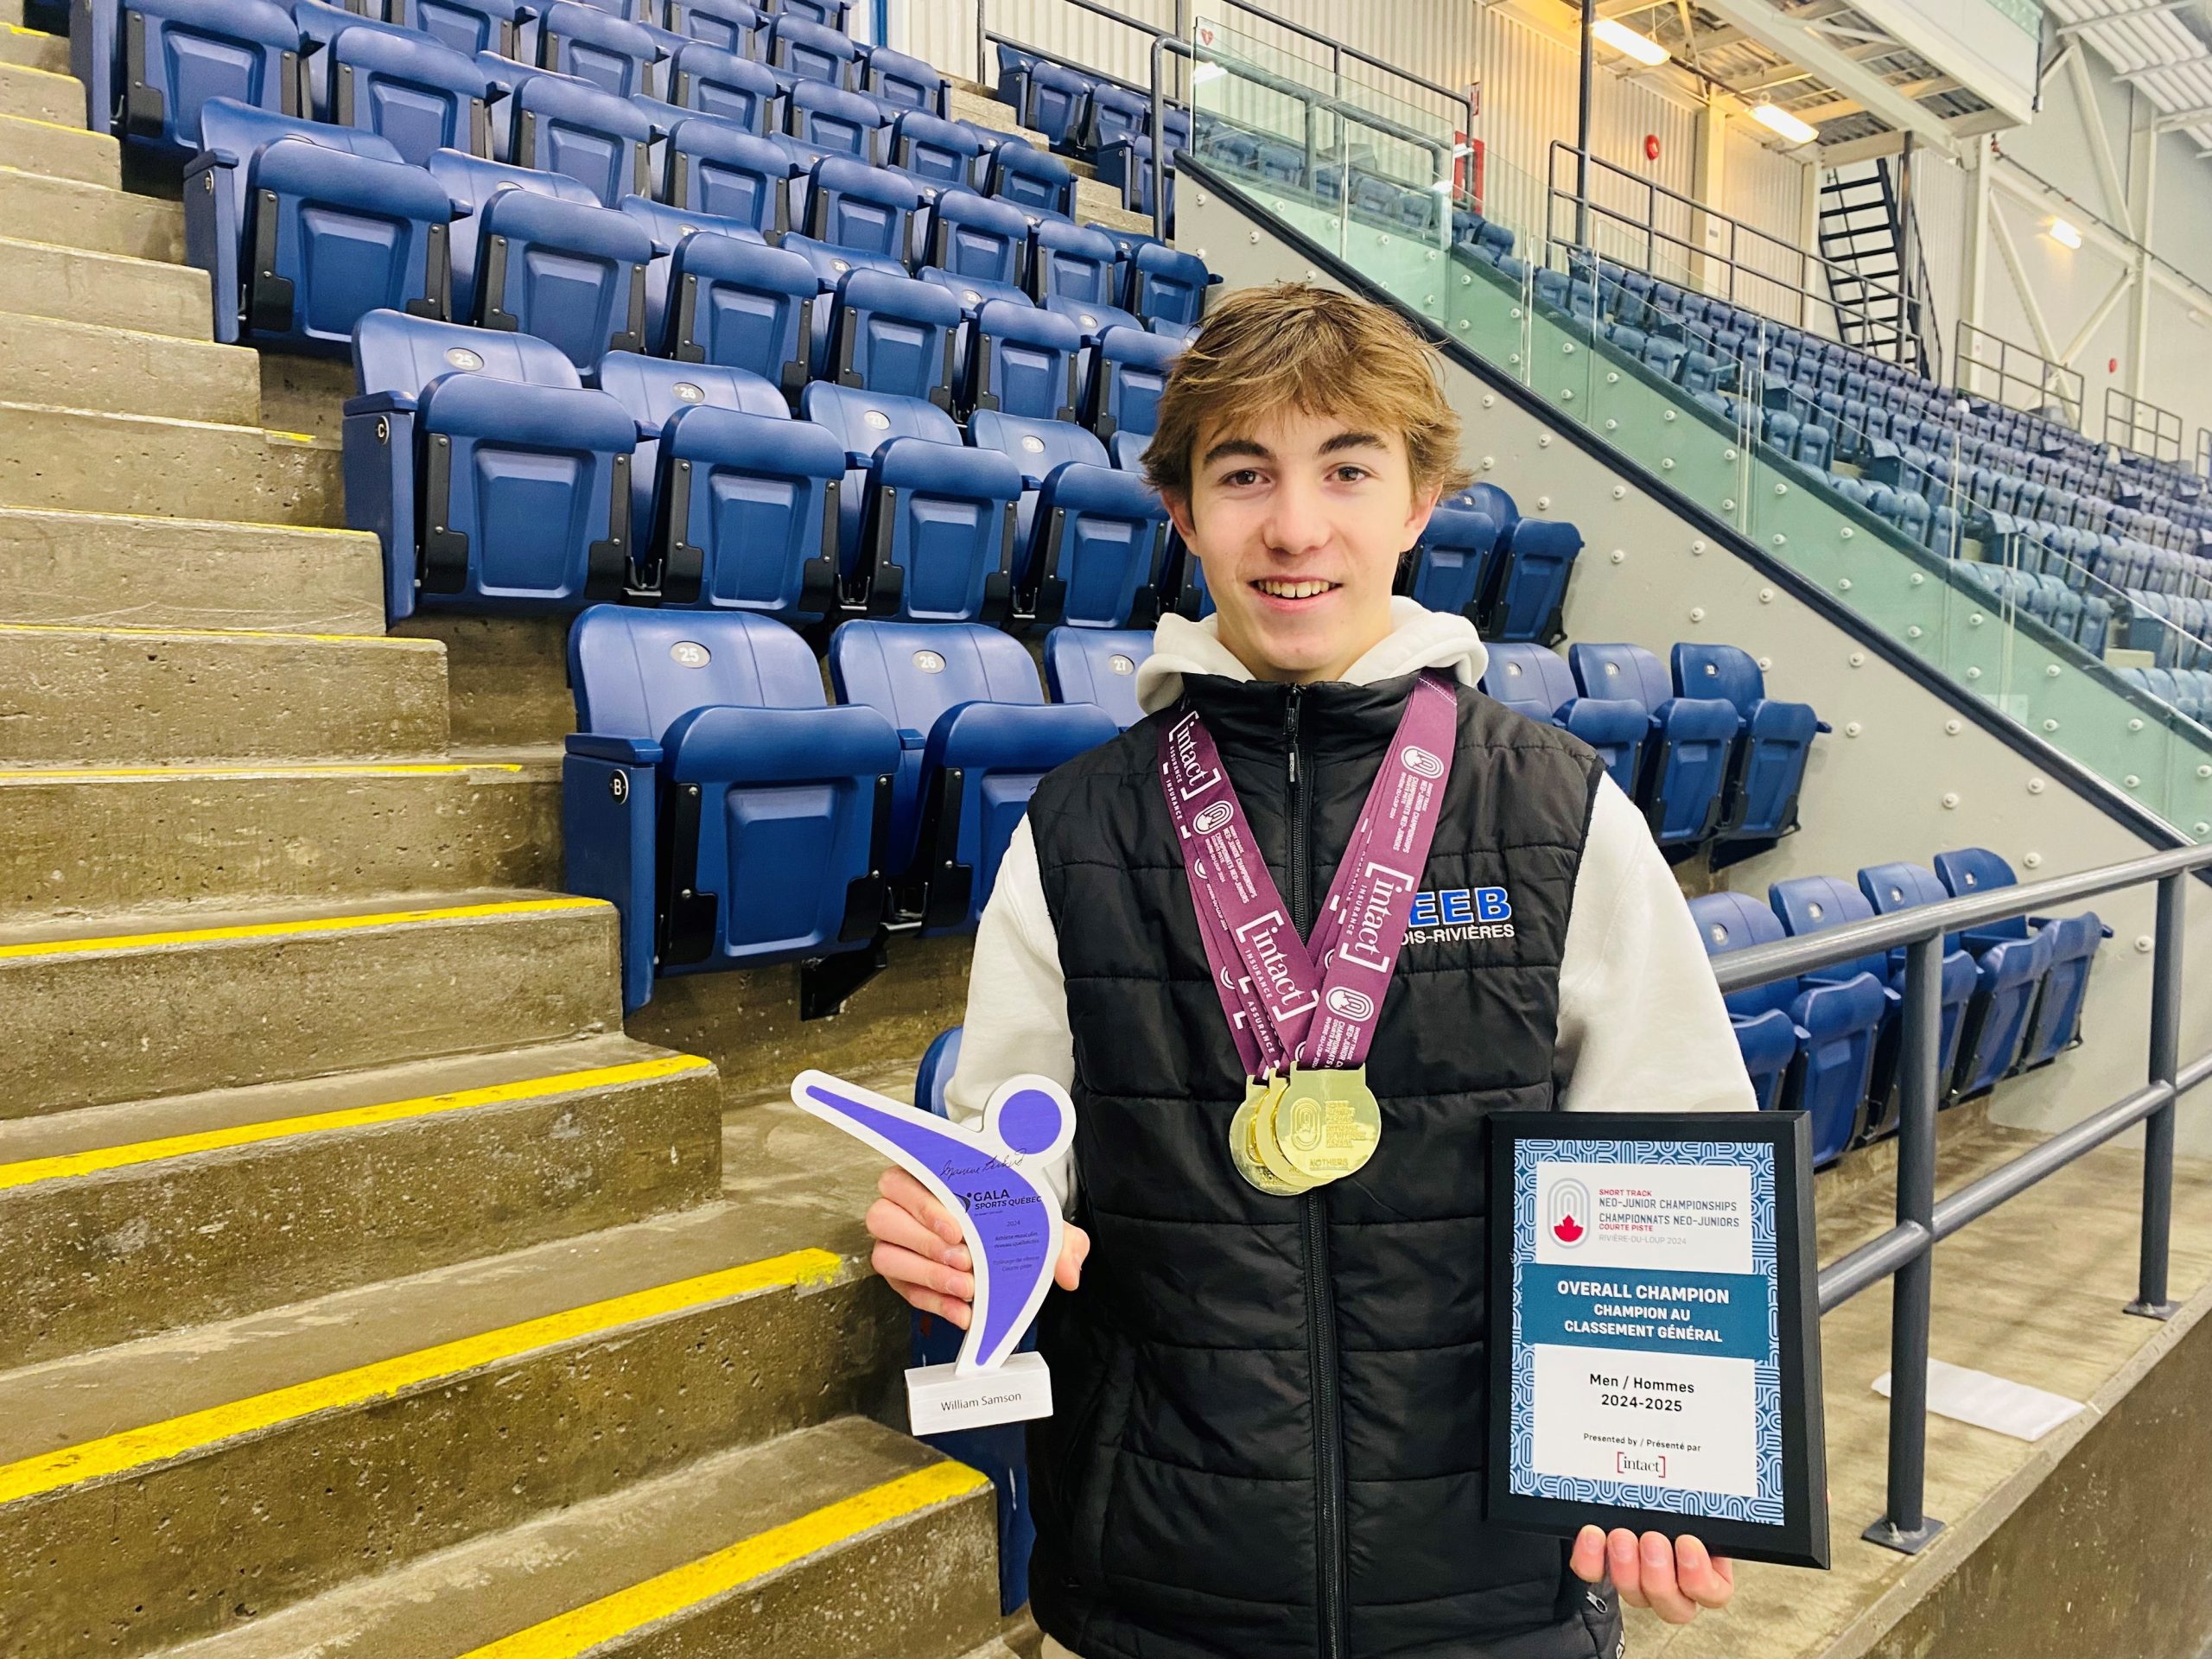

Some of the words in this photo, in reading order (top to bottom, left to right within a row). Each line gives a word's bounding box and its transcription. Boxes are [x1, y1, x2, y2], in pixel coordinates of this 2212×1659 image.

[455, 354, 474, 366] 25
[680, 389, 696, 399] 26
[378, 423, 385, 438] C
[678, 647, 699, 663] 25
[919, 656, 936, 669] 26
[1114, 659, 1127, 671] 27
[1169, 746, 1182, 784] ASSURANCE
[613, 779, 622, 796] B
[1166, 779, 1183, 820] INSURANCE
[1346, 884, 1367, 935] INSURANCE
[1245, 950, 1273, 1000] INSURANCE
[1247, 1001, 1275, 1053] ASSURANCE
[973, 1189, 1010, 1202] GALA
[975, 1200, 1007, 1210] SPORTS
[1008, 1196, 1041, 1206] QUÉBEC
[1599, 1198, 1656, 1209] NEO-JUNIOR
[1660, 1199, 1737, 1211] CHAMPIONSHIPS
[1599, 1213, 1670, 1224] CHAMPIONNATS
[1674, 1217, 1739, 1227] NEO-JUNIORS
[1599, 1234, 1665, 1244] RIVIÈRE-DU-LOUP
[1557, 1281, 1632, 1299] OVERALL
[1636, 1285, 1729, 1304] CHAMPION
[1594, 1304, 1668, 1319] CHAMPION
[1670, 1308, 1690, 1321] AU
[1564, 1320, 1654, 1338] CLASSEMENT
[1657, 1324, 1723, 1343] GÉNÉRAL
[1590, 1373, 1618, 1387] Men
[1623, 1376, 1629, 1389] /
[1633, 1376, 1694, 1394] Hommes
[941, 1399, 979, 1411] William
[982, 1393, 1021, 1406] Samson
[1601, 1394, 1682, 1412] 2024-2025
[1584, 1433, 1624, 1444] Presented
[1628, 1437, 1637, 1446] by
[1646, 1439, 1685, 1450] Présenté
